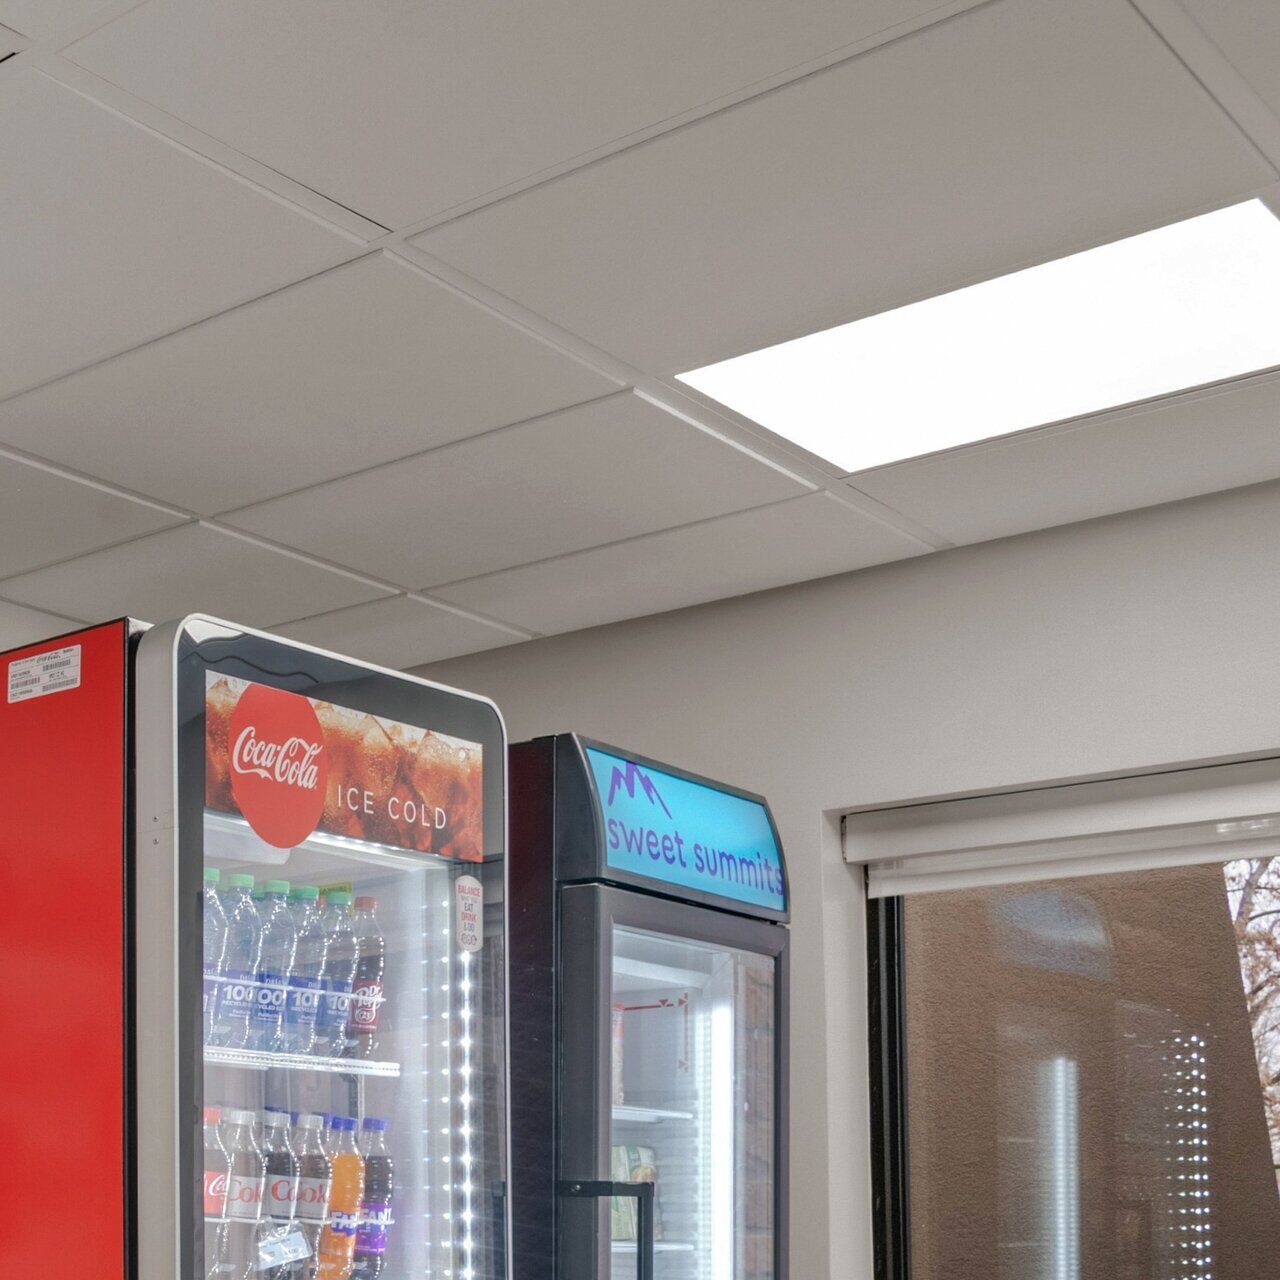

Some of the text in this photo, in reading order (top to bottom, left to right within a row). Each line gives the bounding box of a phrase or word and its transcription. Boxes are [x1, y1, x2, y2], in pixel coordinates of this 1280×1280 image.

[232, 726, 323, 789] Coca-Cola
[337, 784, 447, 830] ICE COLD
[607, 817, 785, 896] sweet summits
